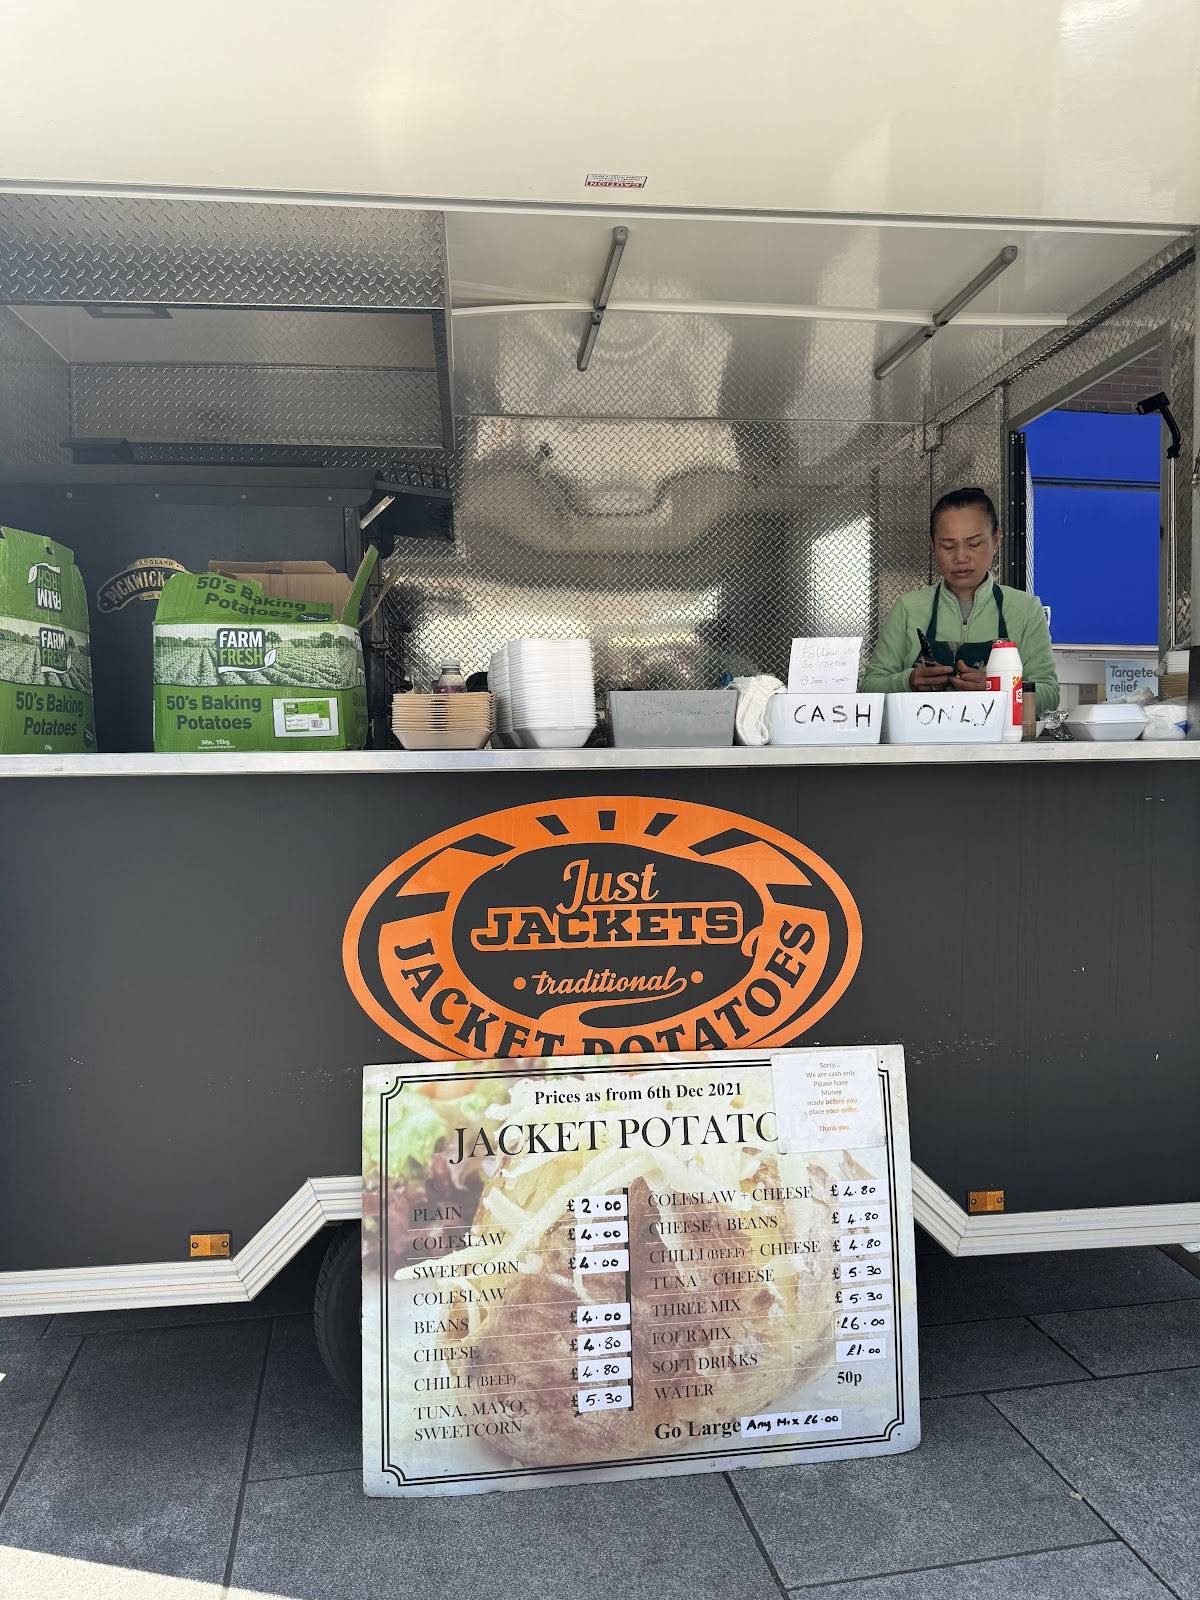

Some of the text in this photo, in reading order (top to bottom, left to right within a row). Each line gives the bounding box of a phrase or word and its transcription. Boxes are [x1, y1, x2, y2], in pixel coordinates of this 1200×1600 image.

[104, 570, 165, 604] PICKWICK
[196, 576, 306, 612] 50's Baking
[205, 592, 292, 618] Potatoes
[41, 630, 66, 650] FARM
[219, 631, 263, 648] FARM
[42, 650, 67, 667] FRESH
[219, 648, 263, 666] FRESH
[1110, 680, 1138, 692] relief
[16, 691, 84, 718] 50's Baking
[166, 695, 262, 713] 50's Baking
[794, 699, 995, 727] CASH ONLY
[24, 716, 77, 737] Potatoes
[176, 714, 253, 730] Potatoes
[555, 859, 659, 915] Just
[474, 904, 740, 947] JACKETS
[531, 966, 688, 995] traditional
[393, 938, 565, 1058] JACKET
[842, 1070, 855, 1078] only
[534, 1082, 742, 1105] Prices as from 6th Dec 2021
[807, 1099, 824, 1107] ready
[821, 1089, 842, 1097] Money
[808, 1108, 825, 1116] place
[449, 1120, 607, 1165] JACKET
[648, 1190, 736, 1208] COLESLAW
[752, 1186, 814, 1202] CHEESE
[413, 1206, 462, 1222] PLAIN
[649, 1219, 711, 1236] CHEESE
[727, 1215, 778, 1232] BEANS
[412, 1232, 506, 1251] COLESLAW
[649, 1248, 704, 1264] CHILLI
[707, 1248, 745, 1261] (BEEF)
[759, 1239, 821, 1257] CHEESE
[412, 1260, 520, 1280] SWEETCORN
[652, 1274, 697, 1290] TUNA
[713, 1269, 775, 1285] CHEESE
[413, 1287, 507, 1306] COLESLAW
[651, 1298, 742, 1317] THREE MIX
[414, 1318, 469, 1335] BEANS
[652, 1327, 732, 1345] FOUR MIX
[413, 1346, 479, 1363] CHEESE
[652, 1353, 759, 1374] SOFT DRINKS
[414, 1374, 516, 1392] CHILLI (BEEF)
[837, 1370, 862, 1386] 50p
[653, 1383, 714, 1401] WATER
[414, 1399, 527, 1421] TUNA, MAYO,
[414, 1420, 522, 1442] SWEETCORN
[654, 1414, 839, 1440] Go Large Any Mix £6.00
